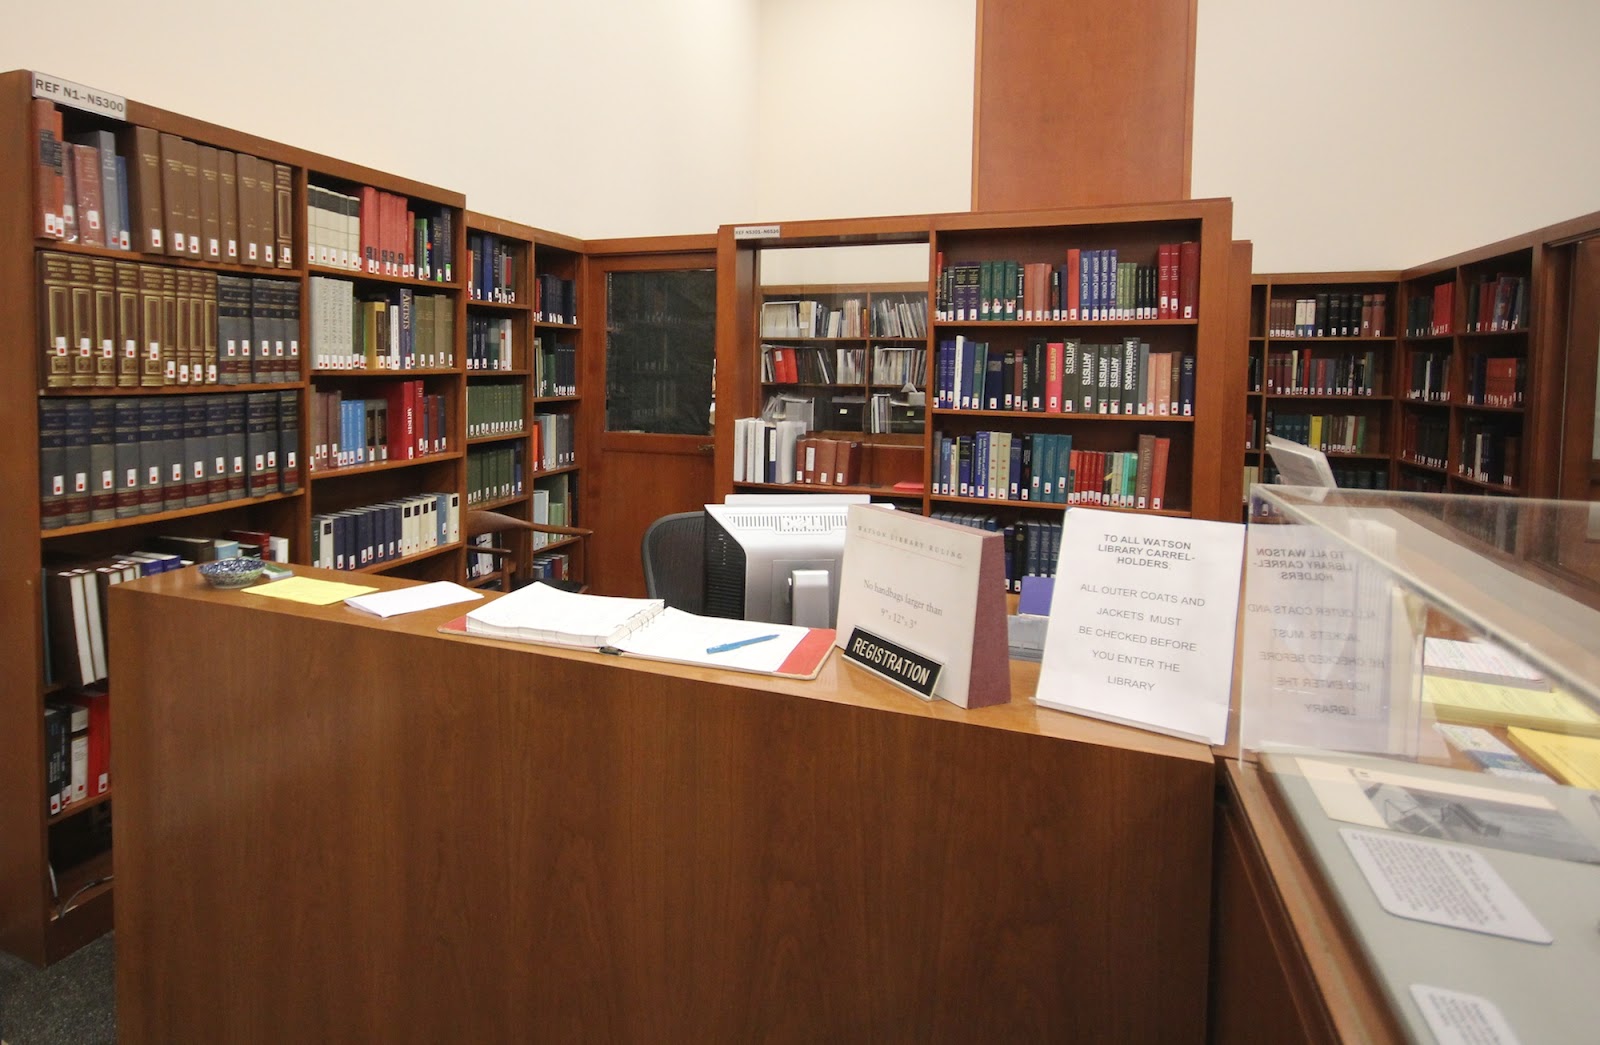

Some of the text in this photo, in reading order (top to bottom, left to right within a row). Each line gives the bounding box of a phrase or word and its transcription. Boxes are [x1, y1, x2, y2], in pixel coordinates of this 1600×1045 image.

[35, 79, 60, 94] REF
[402, 294, 411, 330] ARTISTS
[1065, 342, 1074, 374] ARTISTS
[1082, 352, 1092, 386] ARTISTS
[1098, 357, 1108, 388] ARTISTS
[1110, 357, 1119, 388] ARTISTS
[1124, 341, 1134, 390] MASTERWORKS
[858, 526, 963, 560] WATSON LIBRARY RULING
[1098, 544, 1196, 562] LIBRARY CARREL-
[1104, 534, 1192, 550] TO ALL WATSON
[864, 580, 942, 616] No handbags larger than
[1080, 584, 1206, 607] ALL OUTER COATS AND
[1096, 608, 1182, 626] JACKETS MUST
[1078, 626, 1198, 652] BE CHECKED BEFORE
[853, 638, 930, 686] REGISTRATION
[1092, 650, 1180, 672] YOU ENTER THE
[1108, 676, 1155, 691] LIBRARY
